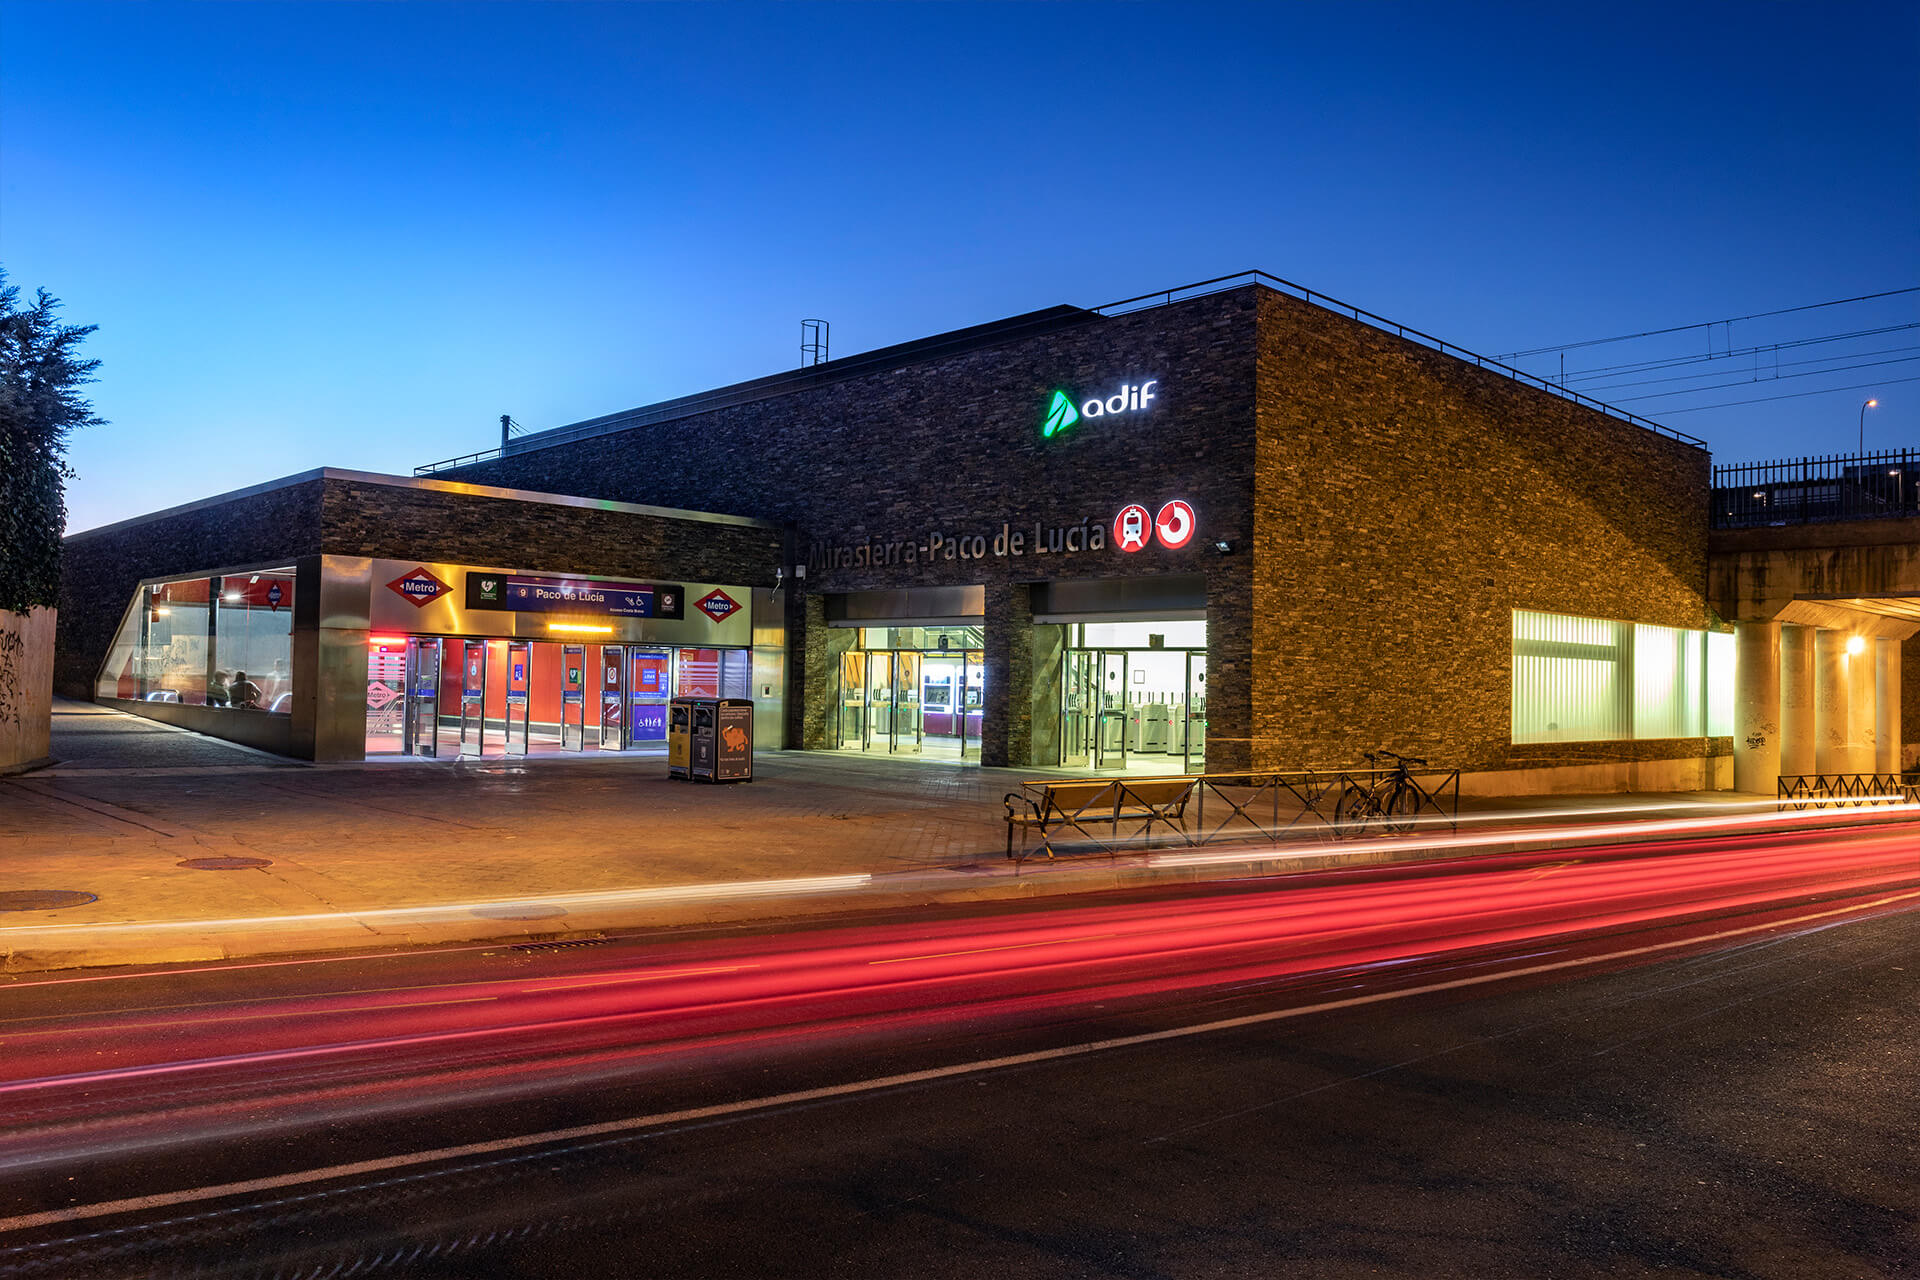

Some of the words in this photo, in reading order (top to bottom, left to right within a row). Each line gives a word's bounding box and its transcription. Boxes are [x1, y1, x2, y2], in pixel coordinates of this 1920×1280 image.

[1082, 380, 1157, 418] adif
[809, 531, 986, 570] Mirasierra-Paco
[994, 523, 1024, 556] de
[1035, 516, 1105, 553] Lucía
[405, 582, 435, 593] Metro
[520, 588, 527, 597] 9
[536, 588, 561, 601] Paco
[564, 592, 576, 601] de
[579, 590, 605, 603] Lucía
[707, 601, 729, 610] Metro
